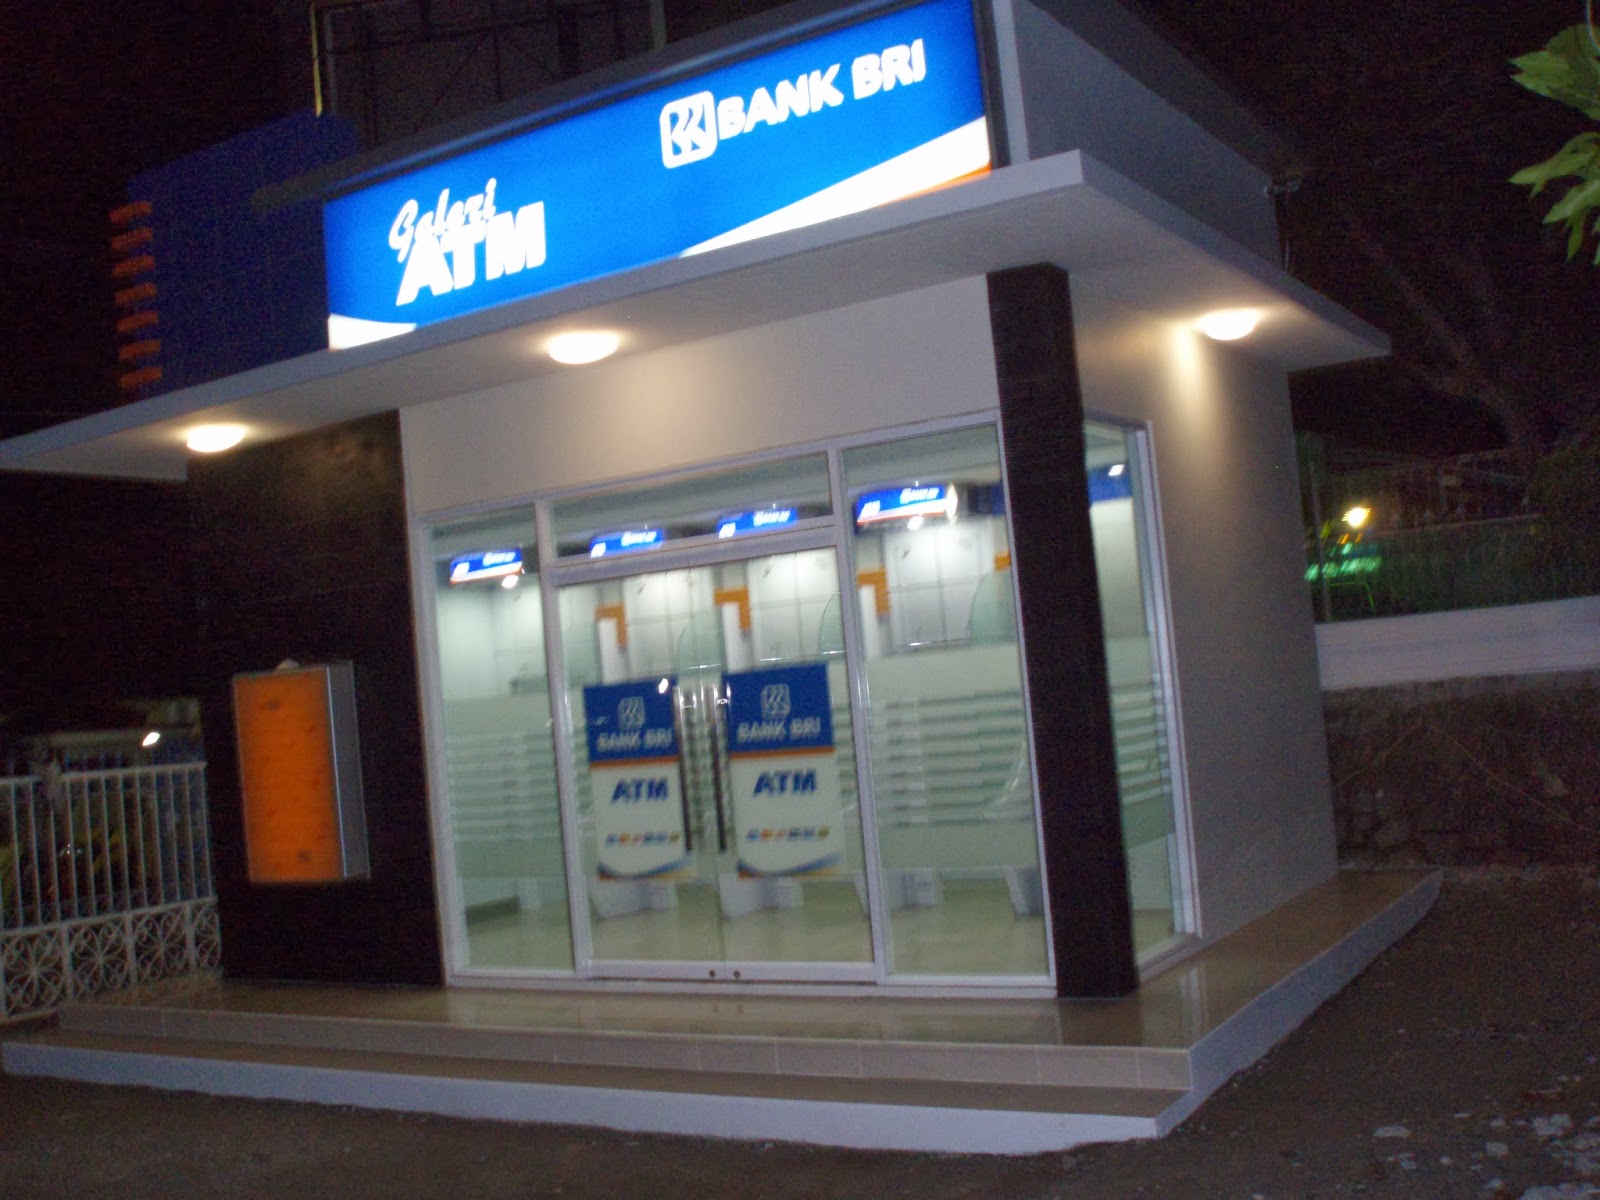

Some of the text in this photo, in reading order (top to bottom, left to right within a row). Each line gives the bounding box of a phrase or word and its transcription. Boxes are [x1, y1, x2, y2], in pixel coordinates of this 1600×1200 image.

[717, 38, 926, 140] BANK BRI
[388, 177, 497, 263] Galeri
[395, 201, 547, 306] ATM
[597, 727, 673, 752] BANK BRI
[737, 717, 821, 743] BANK BRI
[611, 777, 669, 804] ATM
[753, 769, 817, 797] ATM
